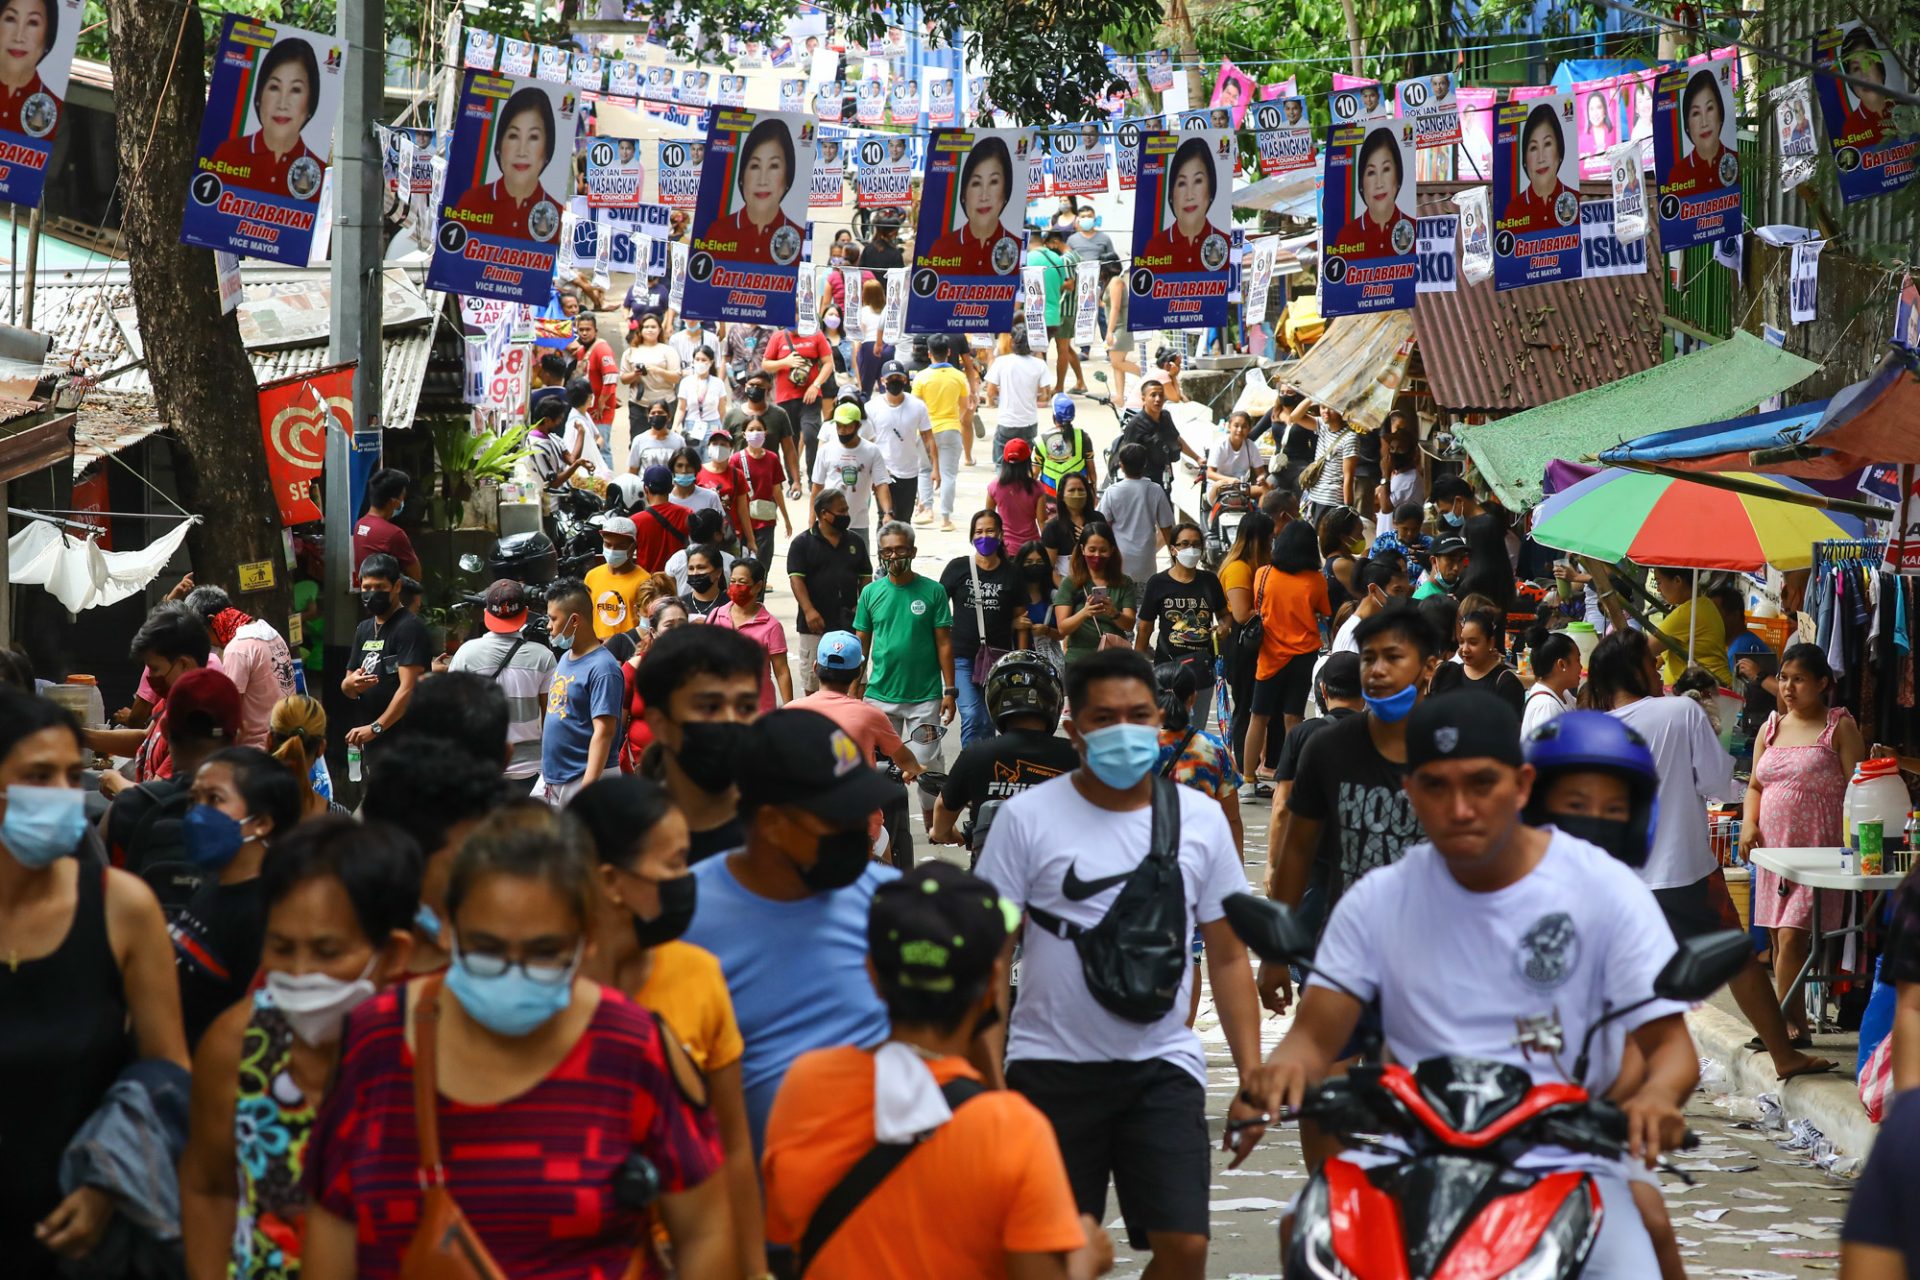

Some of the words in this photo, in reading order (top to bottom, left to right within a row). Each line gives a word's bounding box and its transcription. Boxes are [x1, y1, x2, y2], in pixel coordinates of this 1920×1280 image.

[1406, 84, 1425, 105] 10
[1337, 96, 1355, 117] 10
[1405, 109, 1421, 117] DOK
[1424, 106, 1437, 114] IAN
[1260, 108, 1278, 128] 10
[1416, 112, 1458, 134] ASANGKAY
[1057, 133, 1073, 151] 10
[1121, 126, 1137, 145] 10
[0, 141, 48, 170] BAYAN
[593, 145, 611, 165] 10
[666, 146, 683, 167] 10
[864, 144, 880, 163] 10
[1119, 150, 1134, 158] DOK
[1261, 137, 1311, 158] MASANGKAY
[1861, 140, 1920, 170] GATLABAYA
[198, 157, 252, 178] Re-Elect!!
[1054, 156, 1069, 164] DOK
[607, 168, 619, 176] IAN
[661, 169, 676, 178] DOK
[679, 170, 692, 178] IAN
[860, 168, 876, 176] DOK
[1055, 162, 1105, 182] MASANGKAY
[589, 177, 638, 195] MASANGKAY
[661, 179, 700, 196] MASANGK
[811, 177, 841, 194] ANGKAY
[861, 176, 910, 194] MASANGKAY
[1660, 179, 1696, 194] Re-Elect!!
[217, 190, 315, 230] GATLABAYAN
[1680, 192, 1741, 220] GATLABAYAN
[443, 206, 494, 225] Re-Elect!!
[1496, 217, 1531, 230] Re-Elect!!
[1697, 215, 1724, 230] Pining
[236, 220, 280, 243] Pining
[1417, 217, 1457, 239] ITCH
[1693, 232, 1707, 240] VICE
[1708, 226, 1726, 238] MAYOR
[228, 236, 248, 248] VICE
[249, 240, 280, 255] MAYOR
[694, 238, 738, 252] Re-Elect!!
[1326, 242, 1365, 255] Re-Elect!!
[1420, 241, 1432, 251] TO
[1514, 233, 1579, 258] GATLABAYAN
[463, 237, 554, 272] GATLABAYAN
[917, 256, 962, 267] Re-Elect!!
[1134, 255, 1173, 266] Re-Elect!!
[1530, 254, 1559, 269] Pining
[482, 265, 523, 285] Pining
[710, 265, 796, 293] GATLABAYAN
[1345, 262, 1416, 286] GATLABAYAN
[1526, 271, 1540, 280] VICE
[1541, 268, 1562, 277] MAYOR
[475, 281, 494, 292] VICE
[495, 284, 523, 296] MAYOR
[935, 280, 1016, 301] GATLABAYAN
[1152, 278, 1227, 299] GATLABAYAN
[1362, 284, 1393, 298] Pining
[469, 298, 482, 310] 20
[728, 290, 767, 308] Pining
[1168, 300, 1202, 313] Pining
[1357, 300, 1373, 308] VICE
[1374, 297, 1396, 306] MAYOR
[721, 306, 739, 316] VICE
[741, 308, 767, 318] MAYOR
[953, 303, 989, 317] Pining
[1163, 315, 1179, 323] VICE
[1180, 314, 1204, 323] MAYOR
[947, 319, 962, 327] VICE
[964, 319, 989, 327] MAYOR
[597, 603, 618, 611] FUBU
[1338, 782, 1425, 837] HOO
